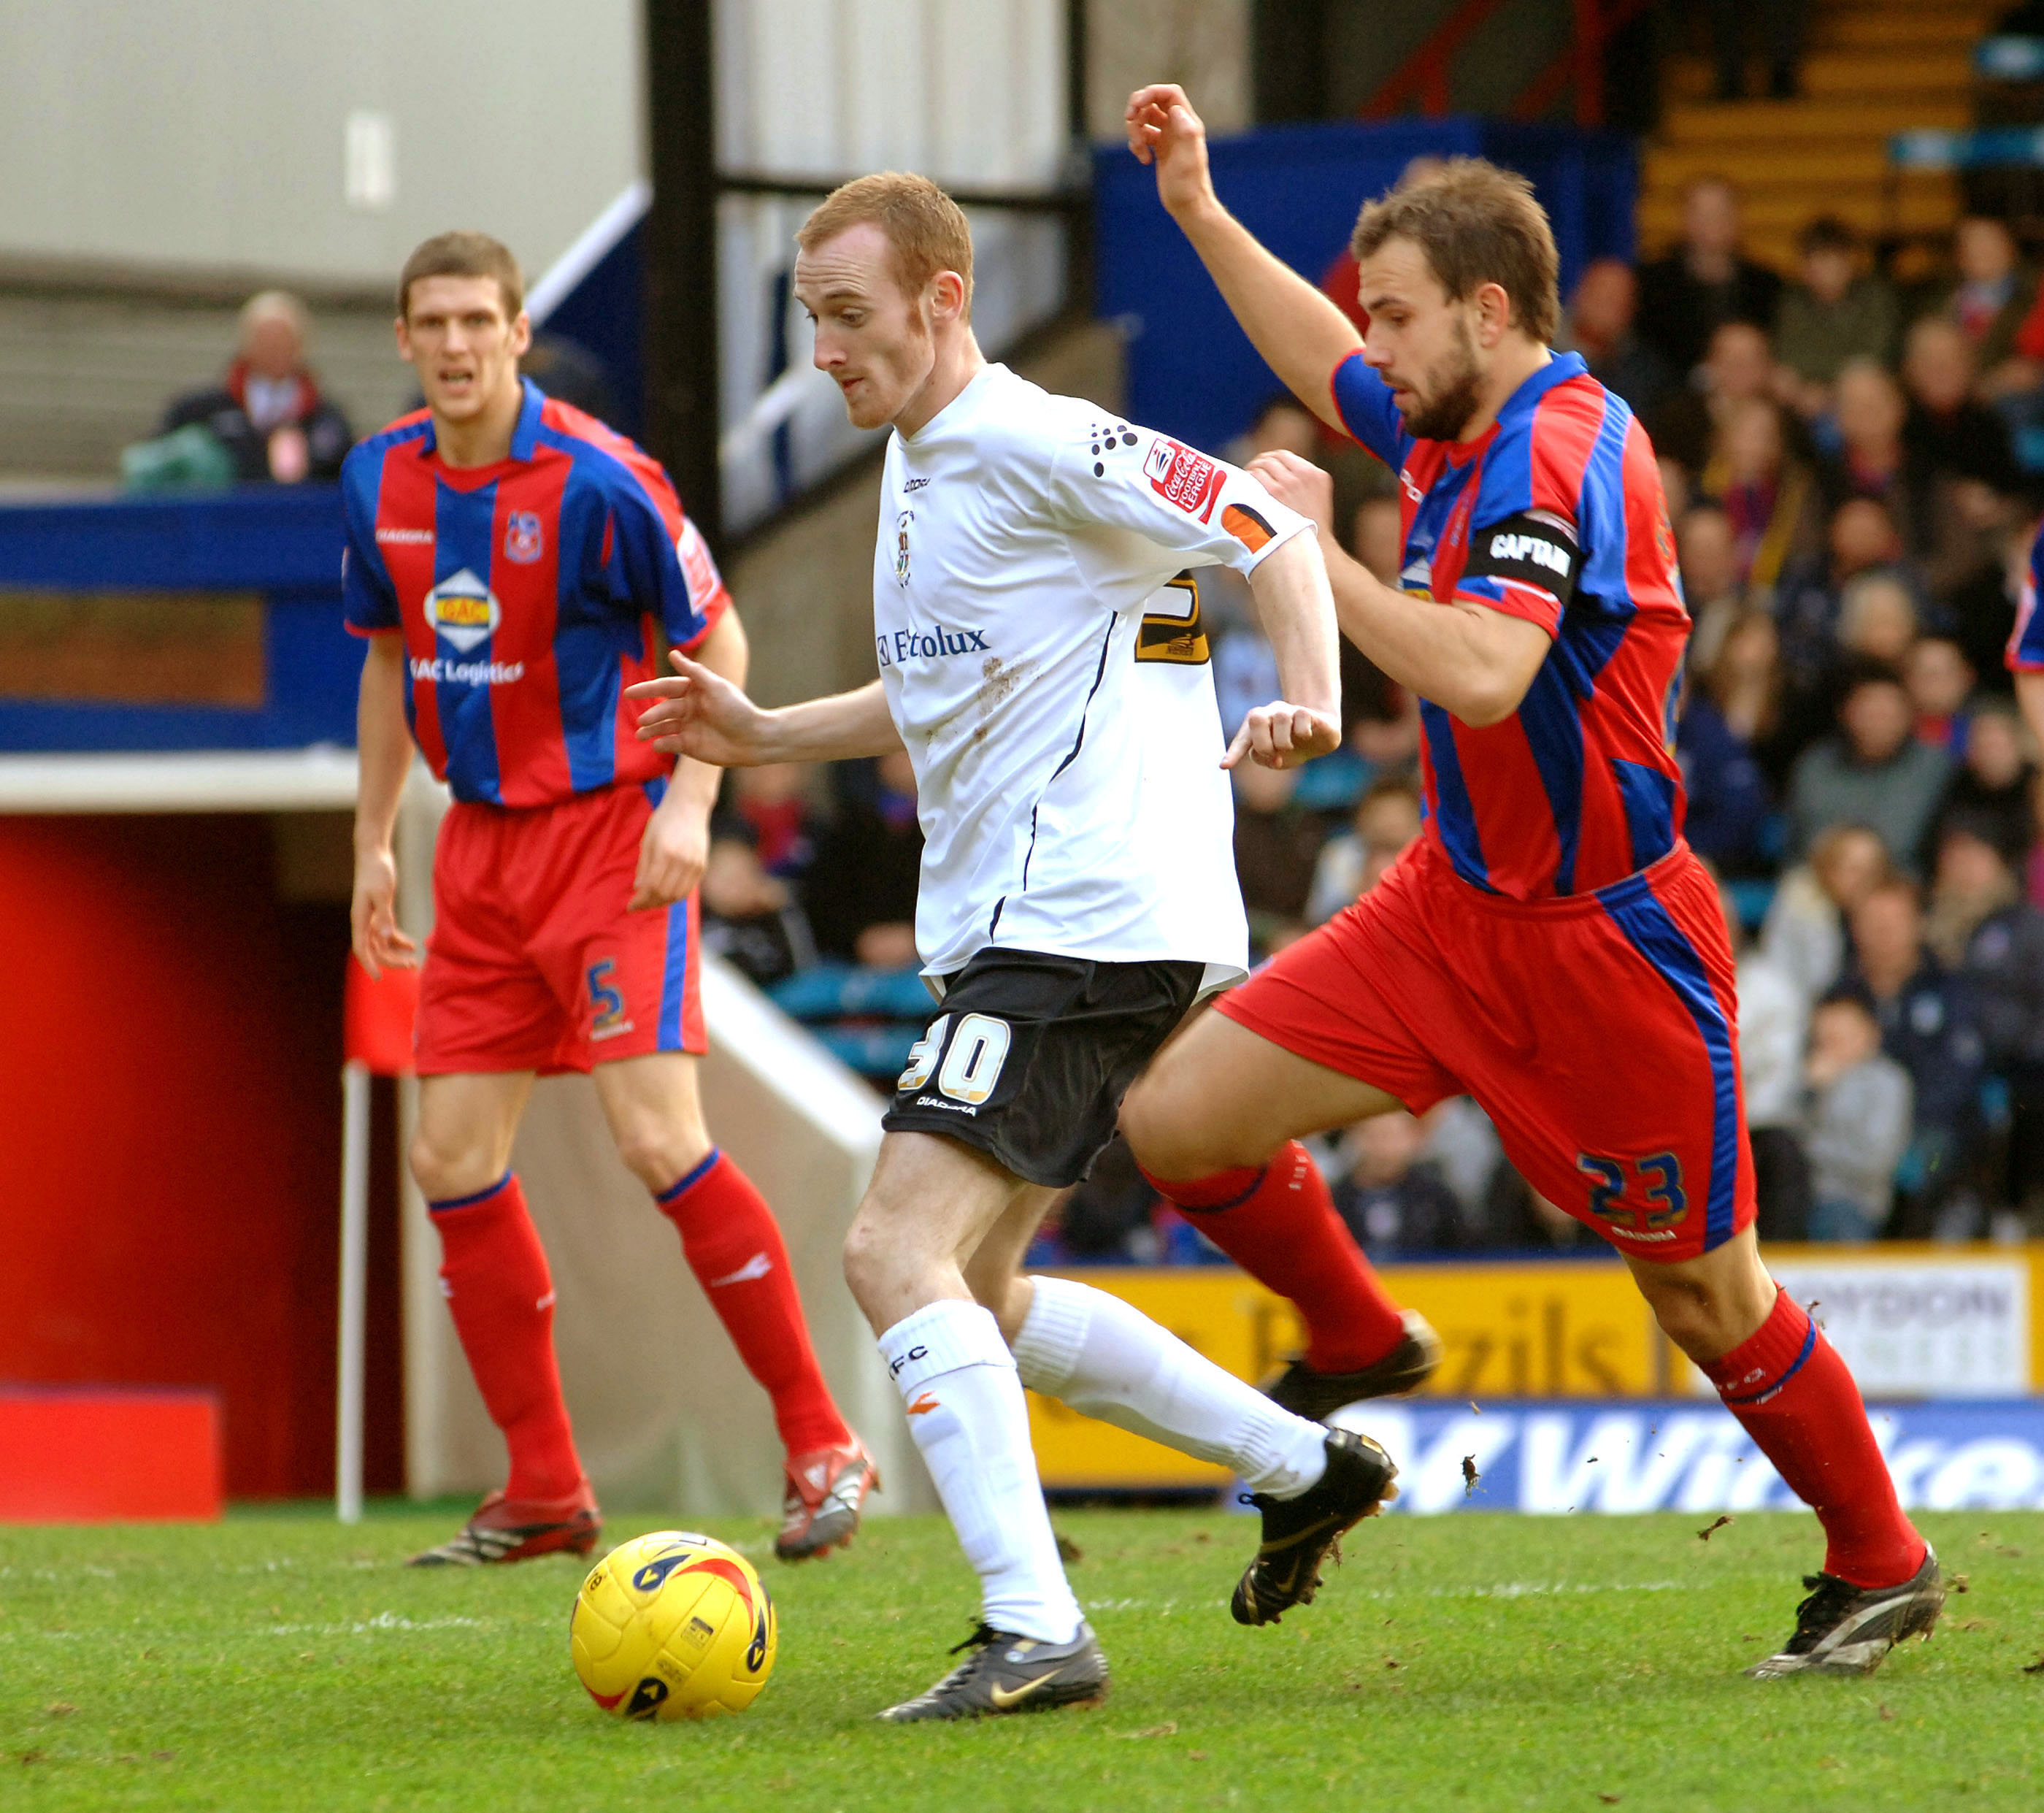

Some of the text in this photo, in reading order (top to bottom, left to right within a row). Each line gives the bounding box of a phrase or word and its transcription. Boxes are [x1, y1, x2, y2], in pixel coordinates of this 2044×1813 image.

[1179, 459, 1202, 505] FOOTBALL
[1184, 461, 1213, 510] LEAGUE
[1490, 534, 1571, 578] CAPTAIN
[586, 958, 625, 1031] 5
[897, 1013, 1011, 1105] 30
[1577, 1151, 1688, 1229] 23
